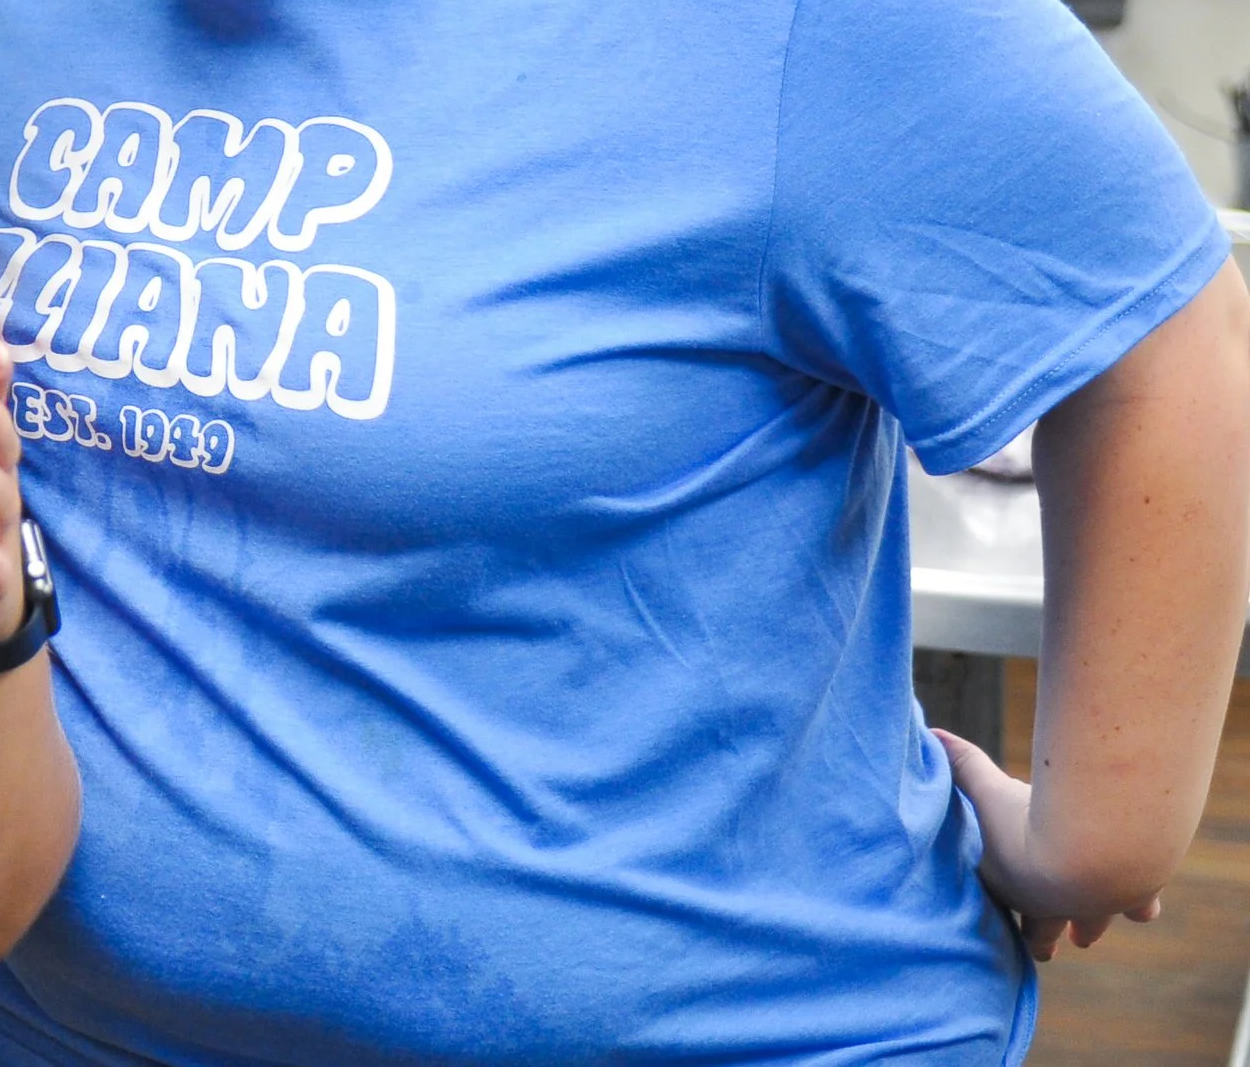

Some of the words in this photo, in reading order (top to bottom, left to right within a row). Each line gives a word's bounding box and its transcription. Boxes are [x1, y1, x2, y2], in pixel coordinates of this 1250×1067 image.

[9, 97, 393, 252] CAMP
[11, 381, 112, 451] EST.
[119, 405, 235, 475] 1949
